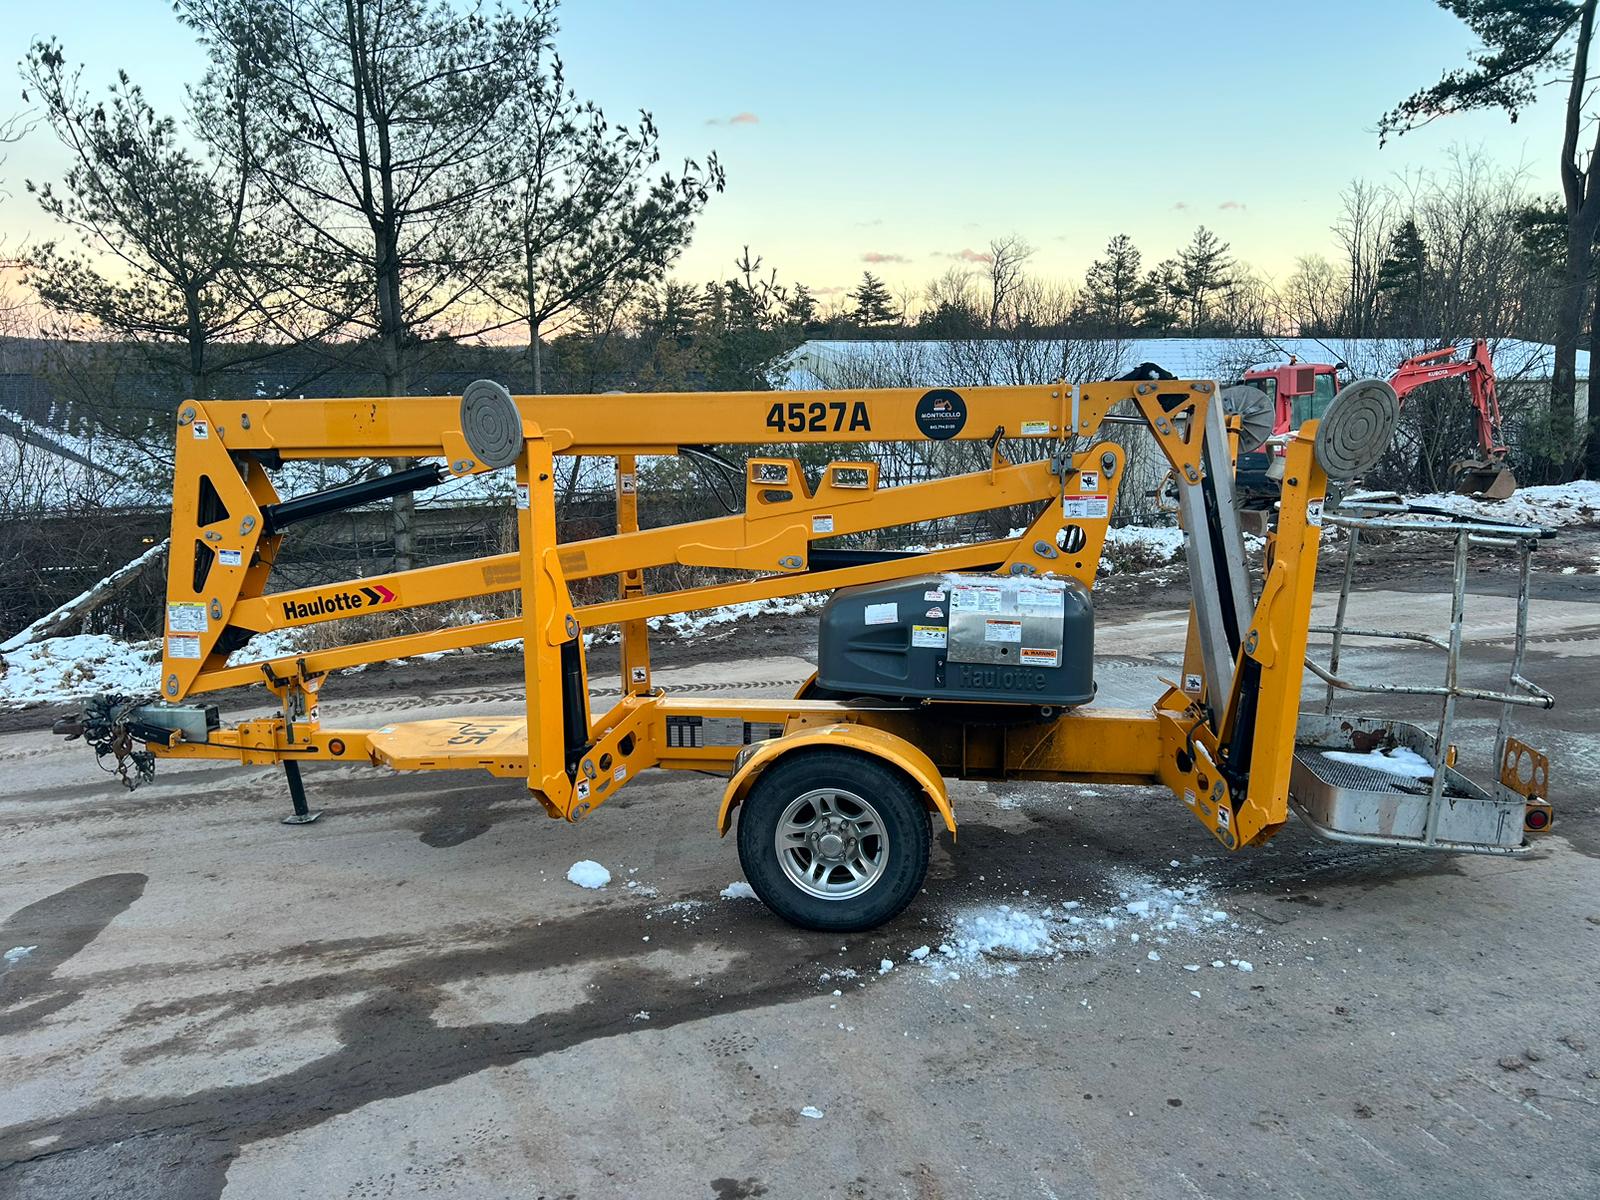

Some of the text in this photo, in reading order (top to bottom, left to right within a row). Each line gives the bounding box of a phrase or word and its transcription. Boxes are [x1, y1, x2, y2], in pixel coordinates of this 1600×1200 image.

[766, 401, 871, 432] 4527A
[282, 592, 362, 620] Haulotte
[959, 664, 1047, 690] Haulotte
